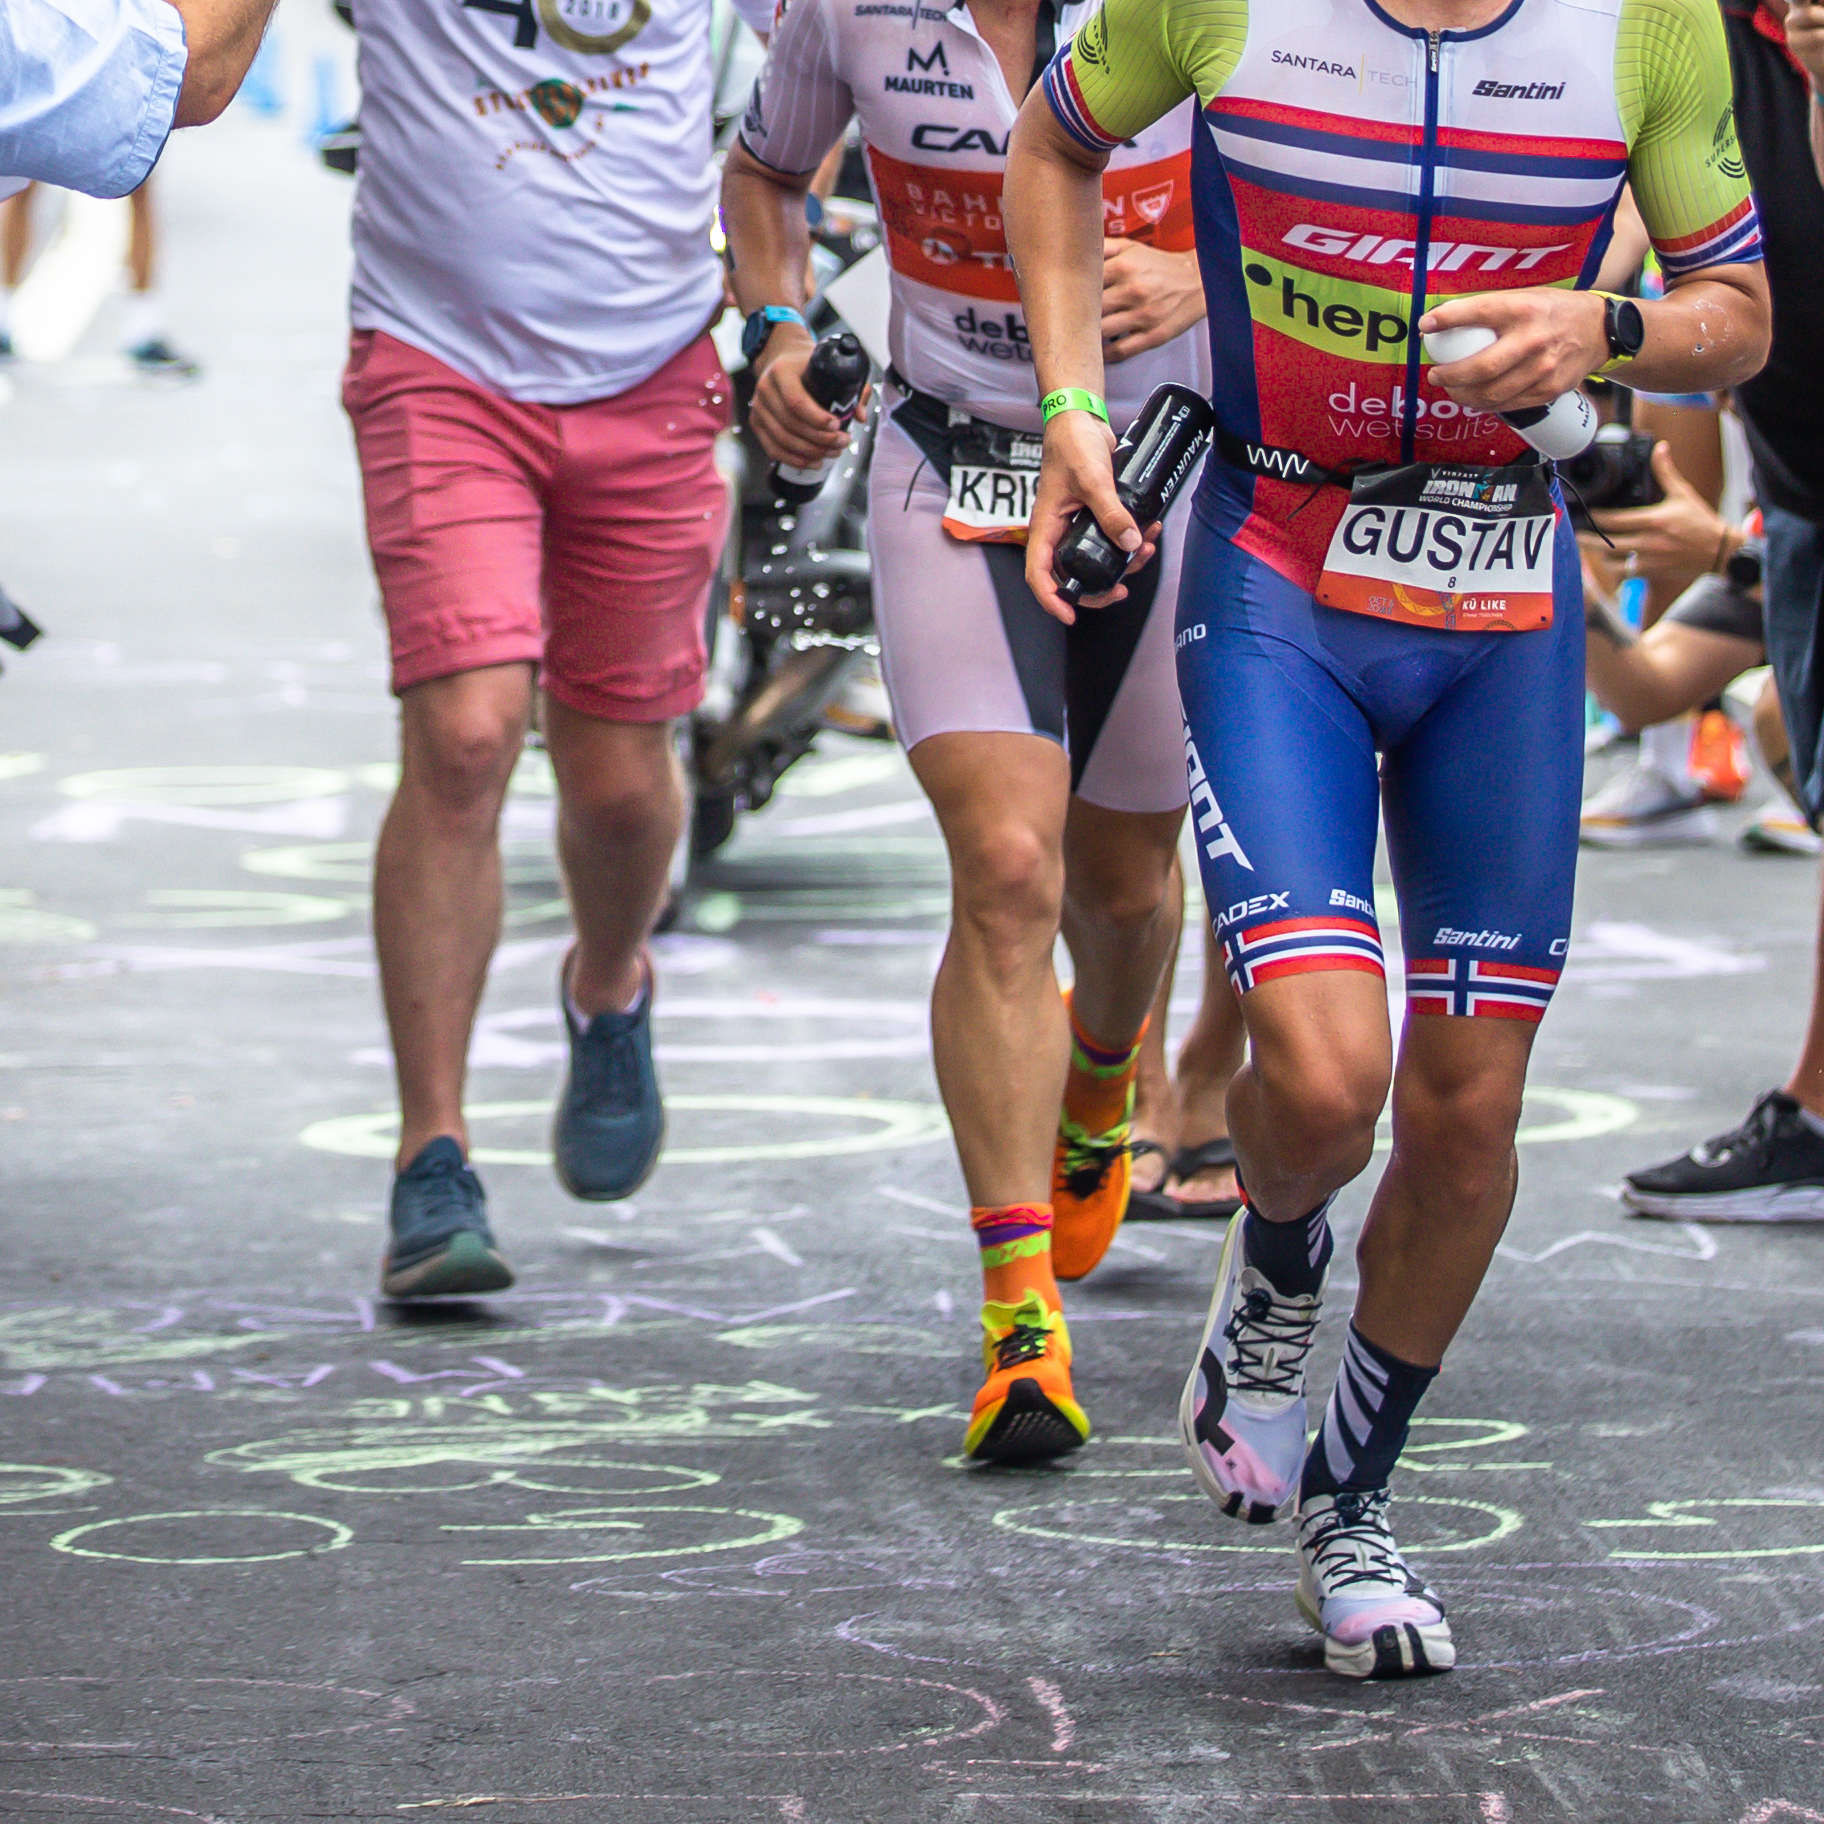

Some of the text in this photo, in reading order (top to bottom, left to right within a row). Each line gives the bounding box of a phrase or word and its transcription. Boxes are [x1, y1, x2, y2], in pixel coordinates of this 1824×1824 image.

[854, 4, 914, 18] SANTARA
[1271, 49, 1357, 80] SANTARA
[884, 75, 974, 100] MAURTEN
[1471, 79, 1567, 101] Santini
[1281, 223, 1574, 271] GIANT
[1159, 428, 1205, 504] MAURTEN
[1418, 494, 1451, 506] WORLD
[1343, 507, 1553, 571] GUSTAV
[1447, 576, 1458, 589] 8
[1480, 599, 1507, 611] LIKE
[1432, 927, 1523, 951] Santini
